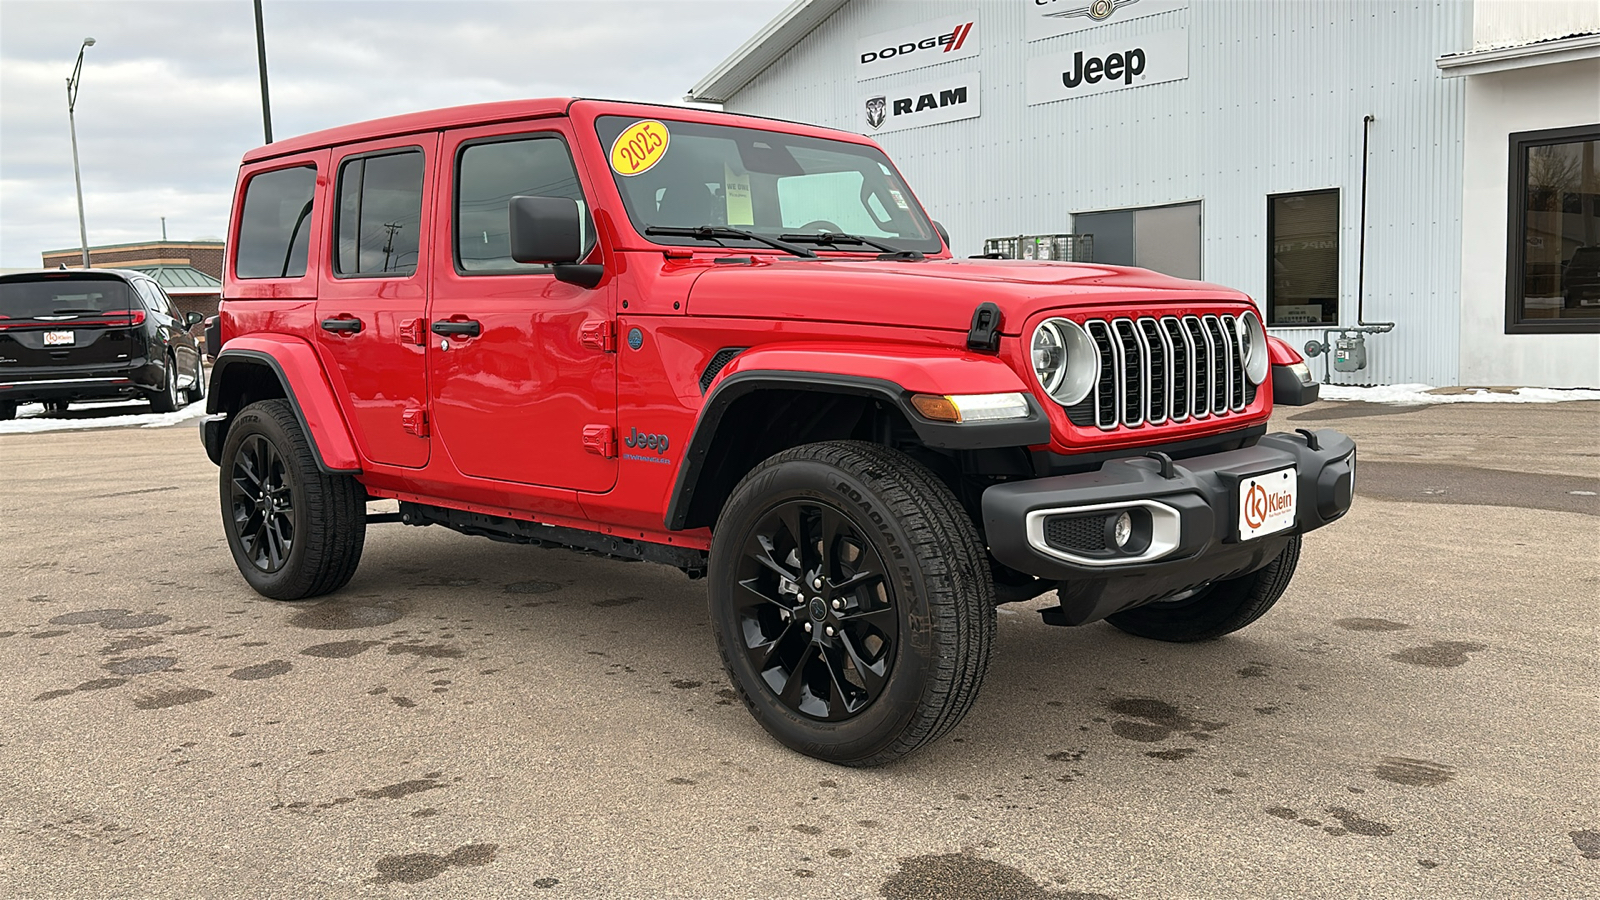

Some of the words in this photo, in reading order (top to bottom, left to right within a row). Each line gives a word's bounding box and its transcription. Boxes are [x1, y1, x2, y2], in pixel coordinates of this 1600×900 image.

[861, 33, 956, 64] DODGE
[1062, 48, 1146, 88] Jeep
[893, 86, 967, 116] RAM
[620, 124, 662, 170] 2025
[625, 426, 669, 455] Jeep
[1269, 490, 1292, 513] Klein
[835, 482, 905, 560] ROADIAN
